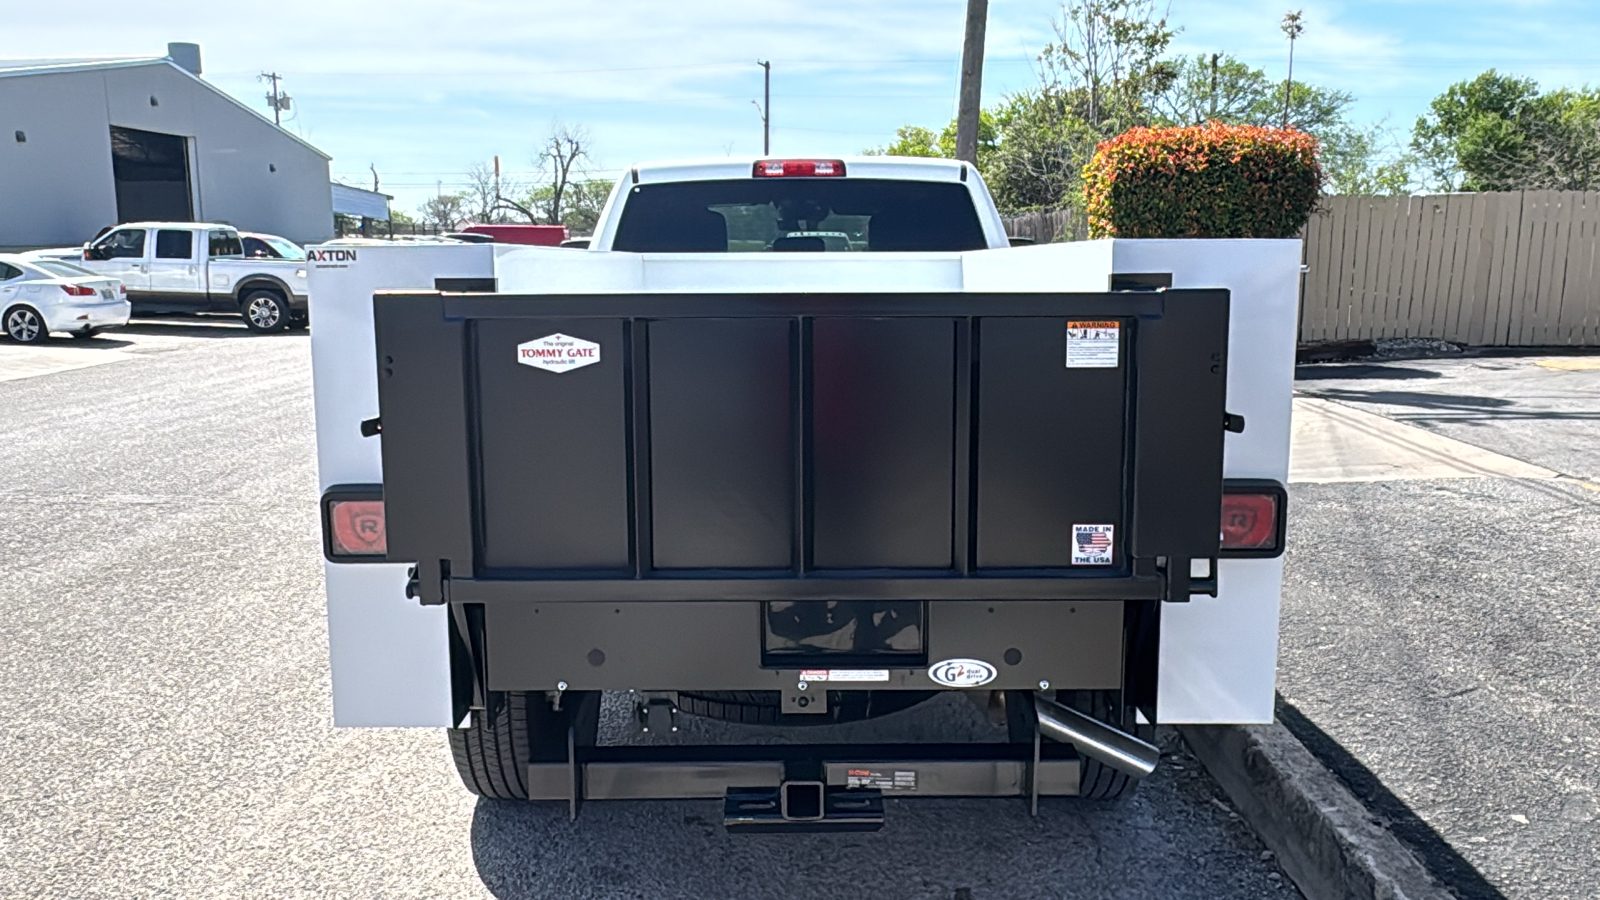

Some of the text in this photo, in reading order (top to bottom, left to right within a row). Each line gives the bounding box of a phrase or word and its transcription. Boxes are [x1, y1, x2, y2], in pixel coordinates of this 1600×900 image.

[307, 249, 357, 261] AXTON
[521, 348, 595, 358] TOMMY GATE
